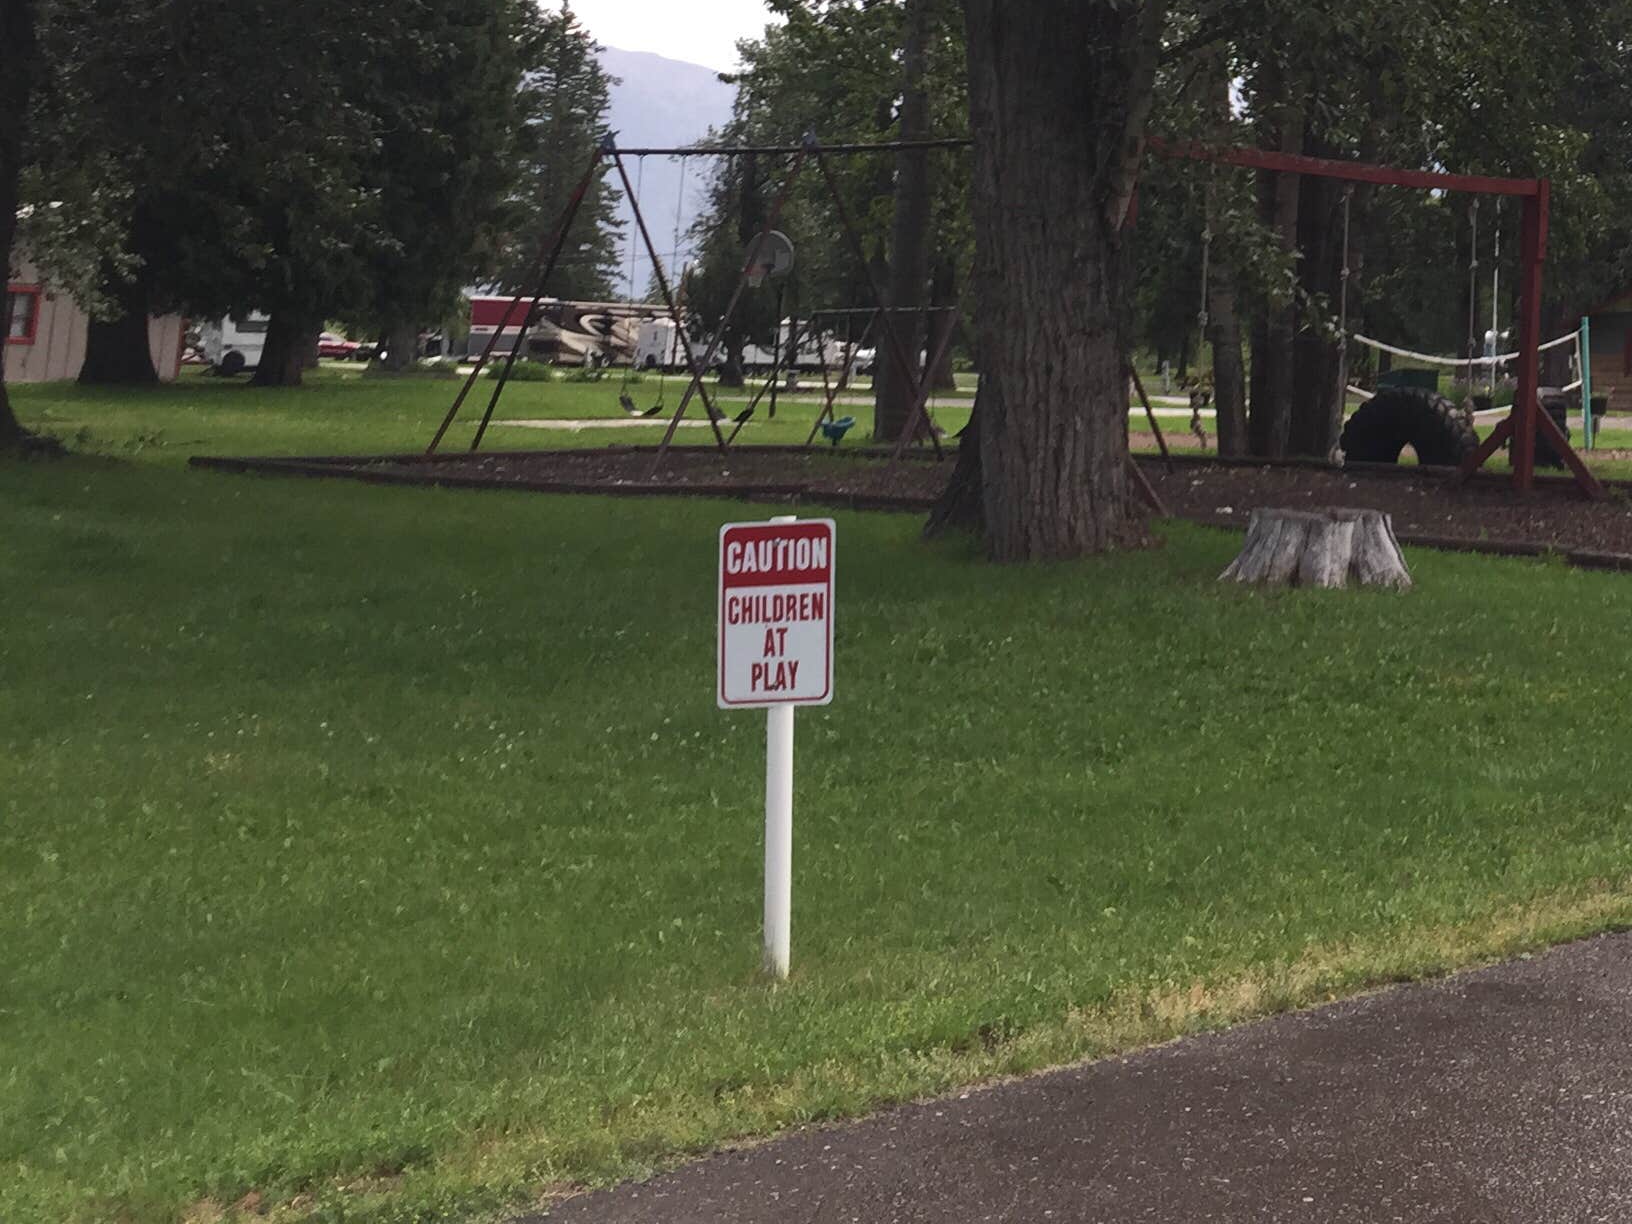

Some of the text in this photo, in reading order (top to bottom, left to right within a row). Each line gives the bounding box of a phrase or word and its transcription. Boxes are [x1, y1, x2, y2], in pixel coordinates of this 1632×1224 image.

[727, 537, 827, 574] CAUTION
[728, 592, 824, 625] CHILDREN
[763, 627, 788, 657] AT
[751, 660, 799, 692] PLAY
